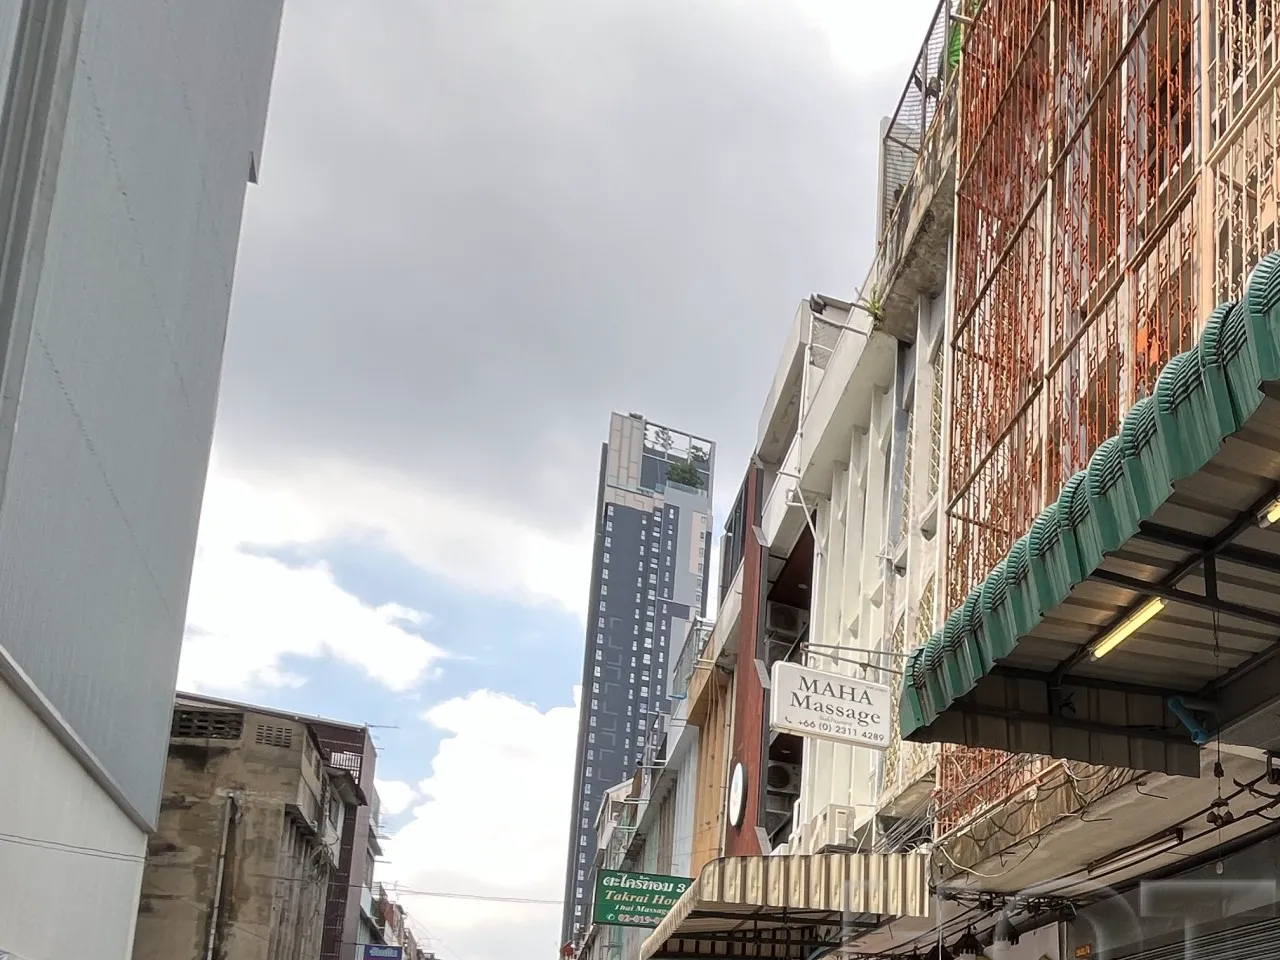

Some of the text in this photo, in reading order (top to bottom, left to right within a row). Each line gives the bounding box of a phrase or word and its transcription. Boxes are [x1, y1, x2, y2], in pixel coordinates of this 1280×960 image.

[798, 676, 873, 706] MAHA
[791, 692, 881, 727] Massage
[798, 719, 884, 742] +66 (0) 2311 4289
[605, 890, 649, 904] Takrai
